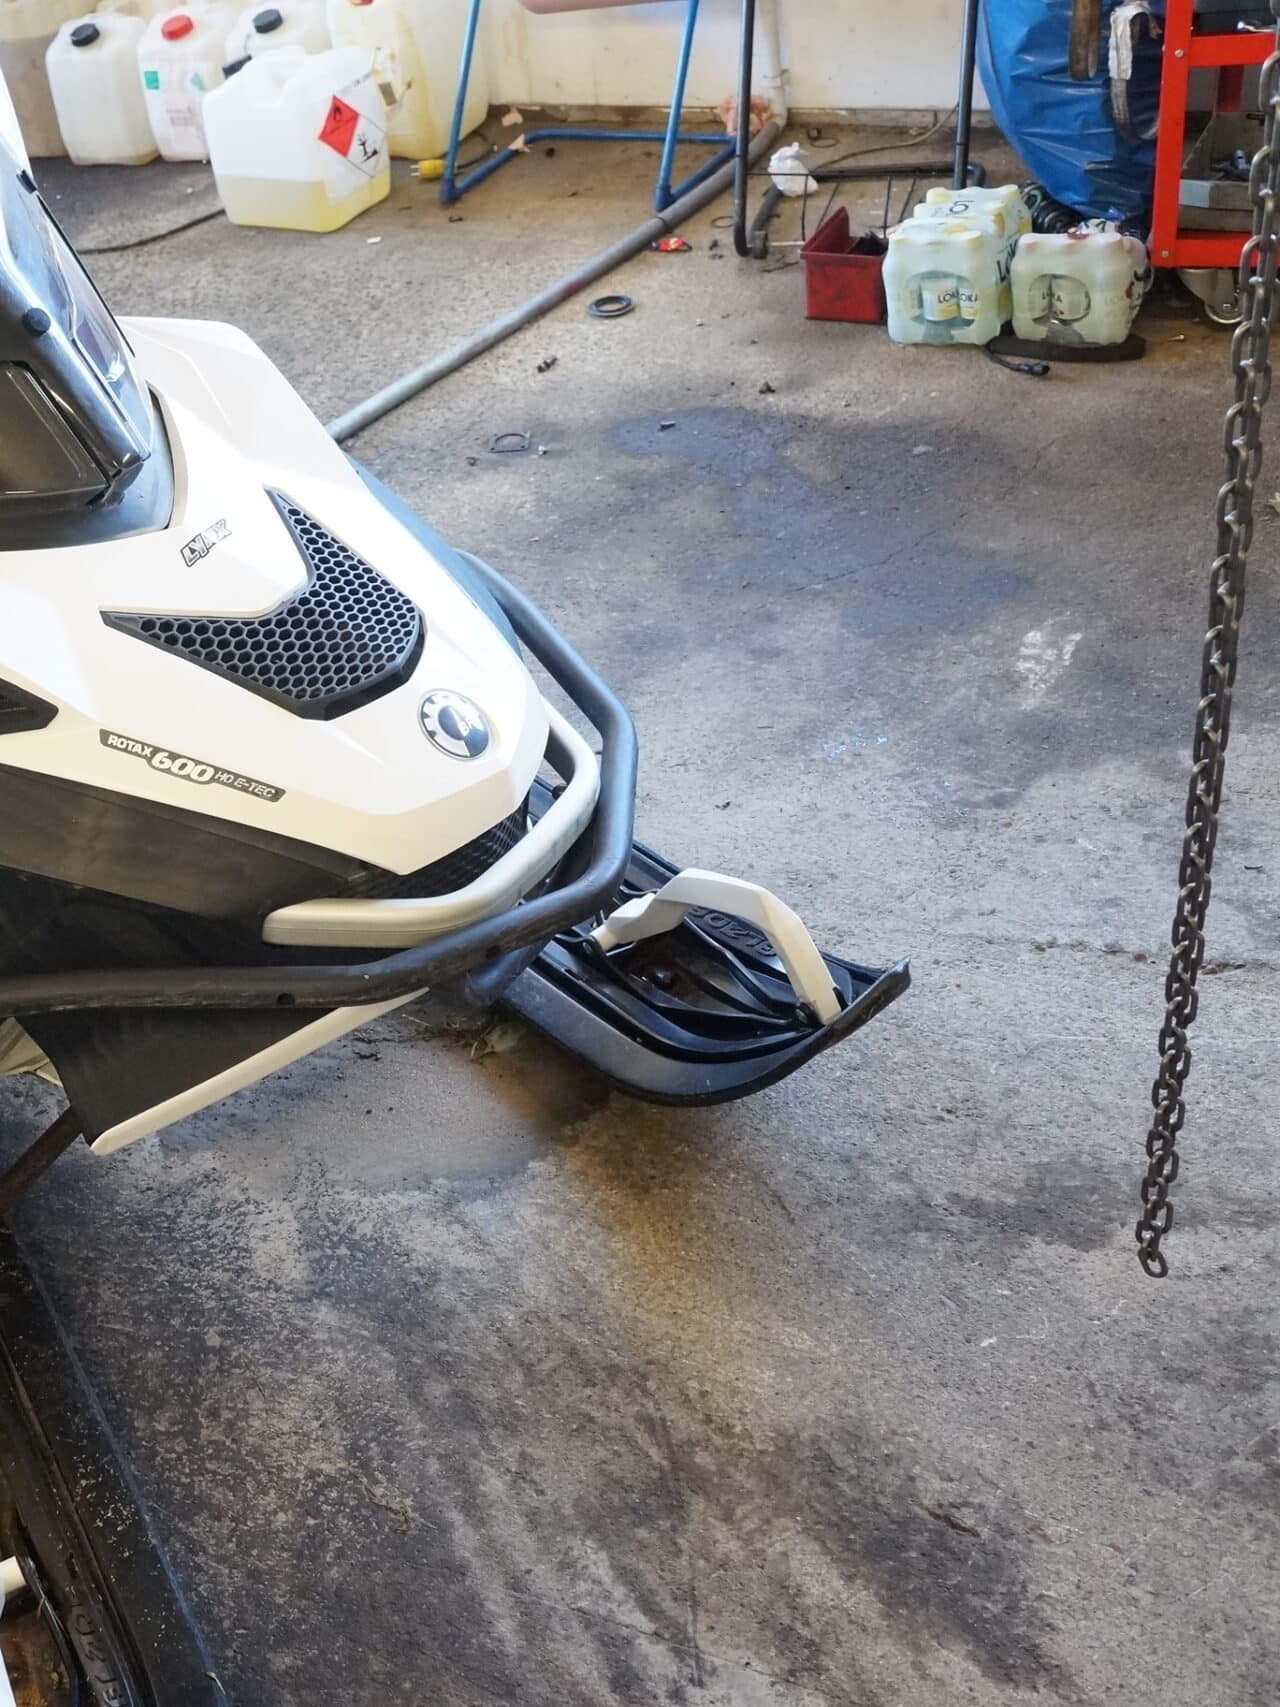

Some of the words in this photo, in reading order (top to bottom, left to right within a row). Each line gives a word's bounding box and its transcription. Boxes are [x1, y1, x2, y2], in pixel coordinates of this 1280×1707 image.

[107, 734, 153, 758] ROTAX
[151, 751, 216, 782] 600
[214, 770, 235, 784] HO
[234, 777, 277, 799] E-TEC
